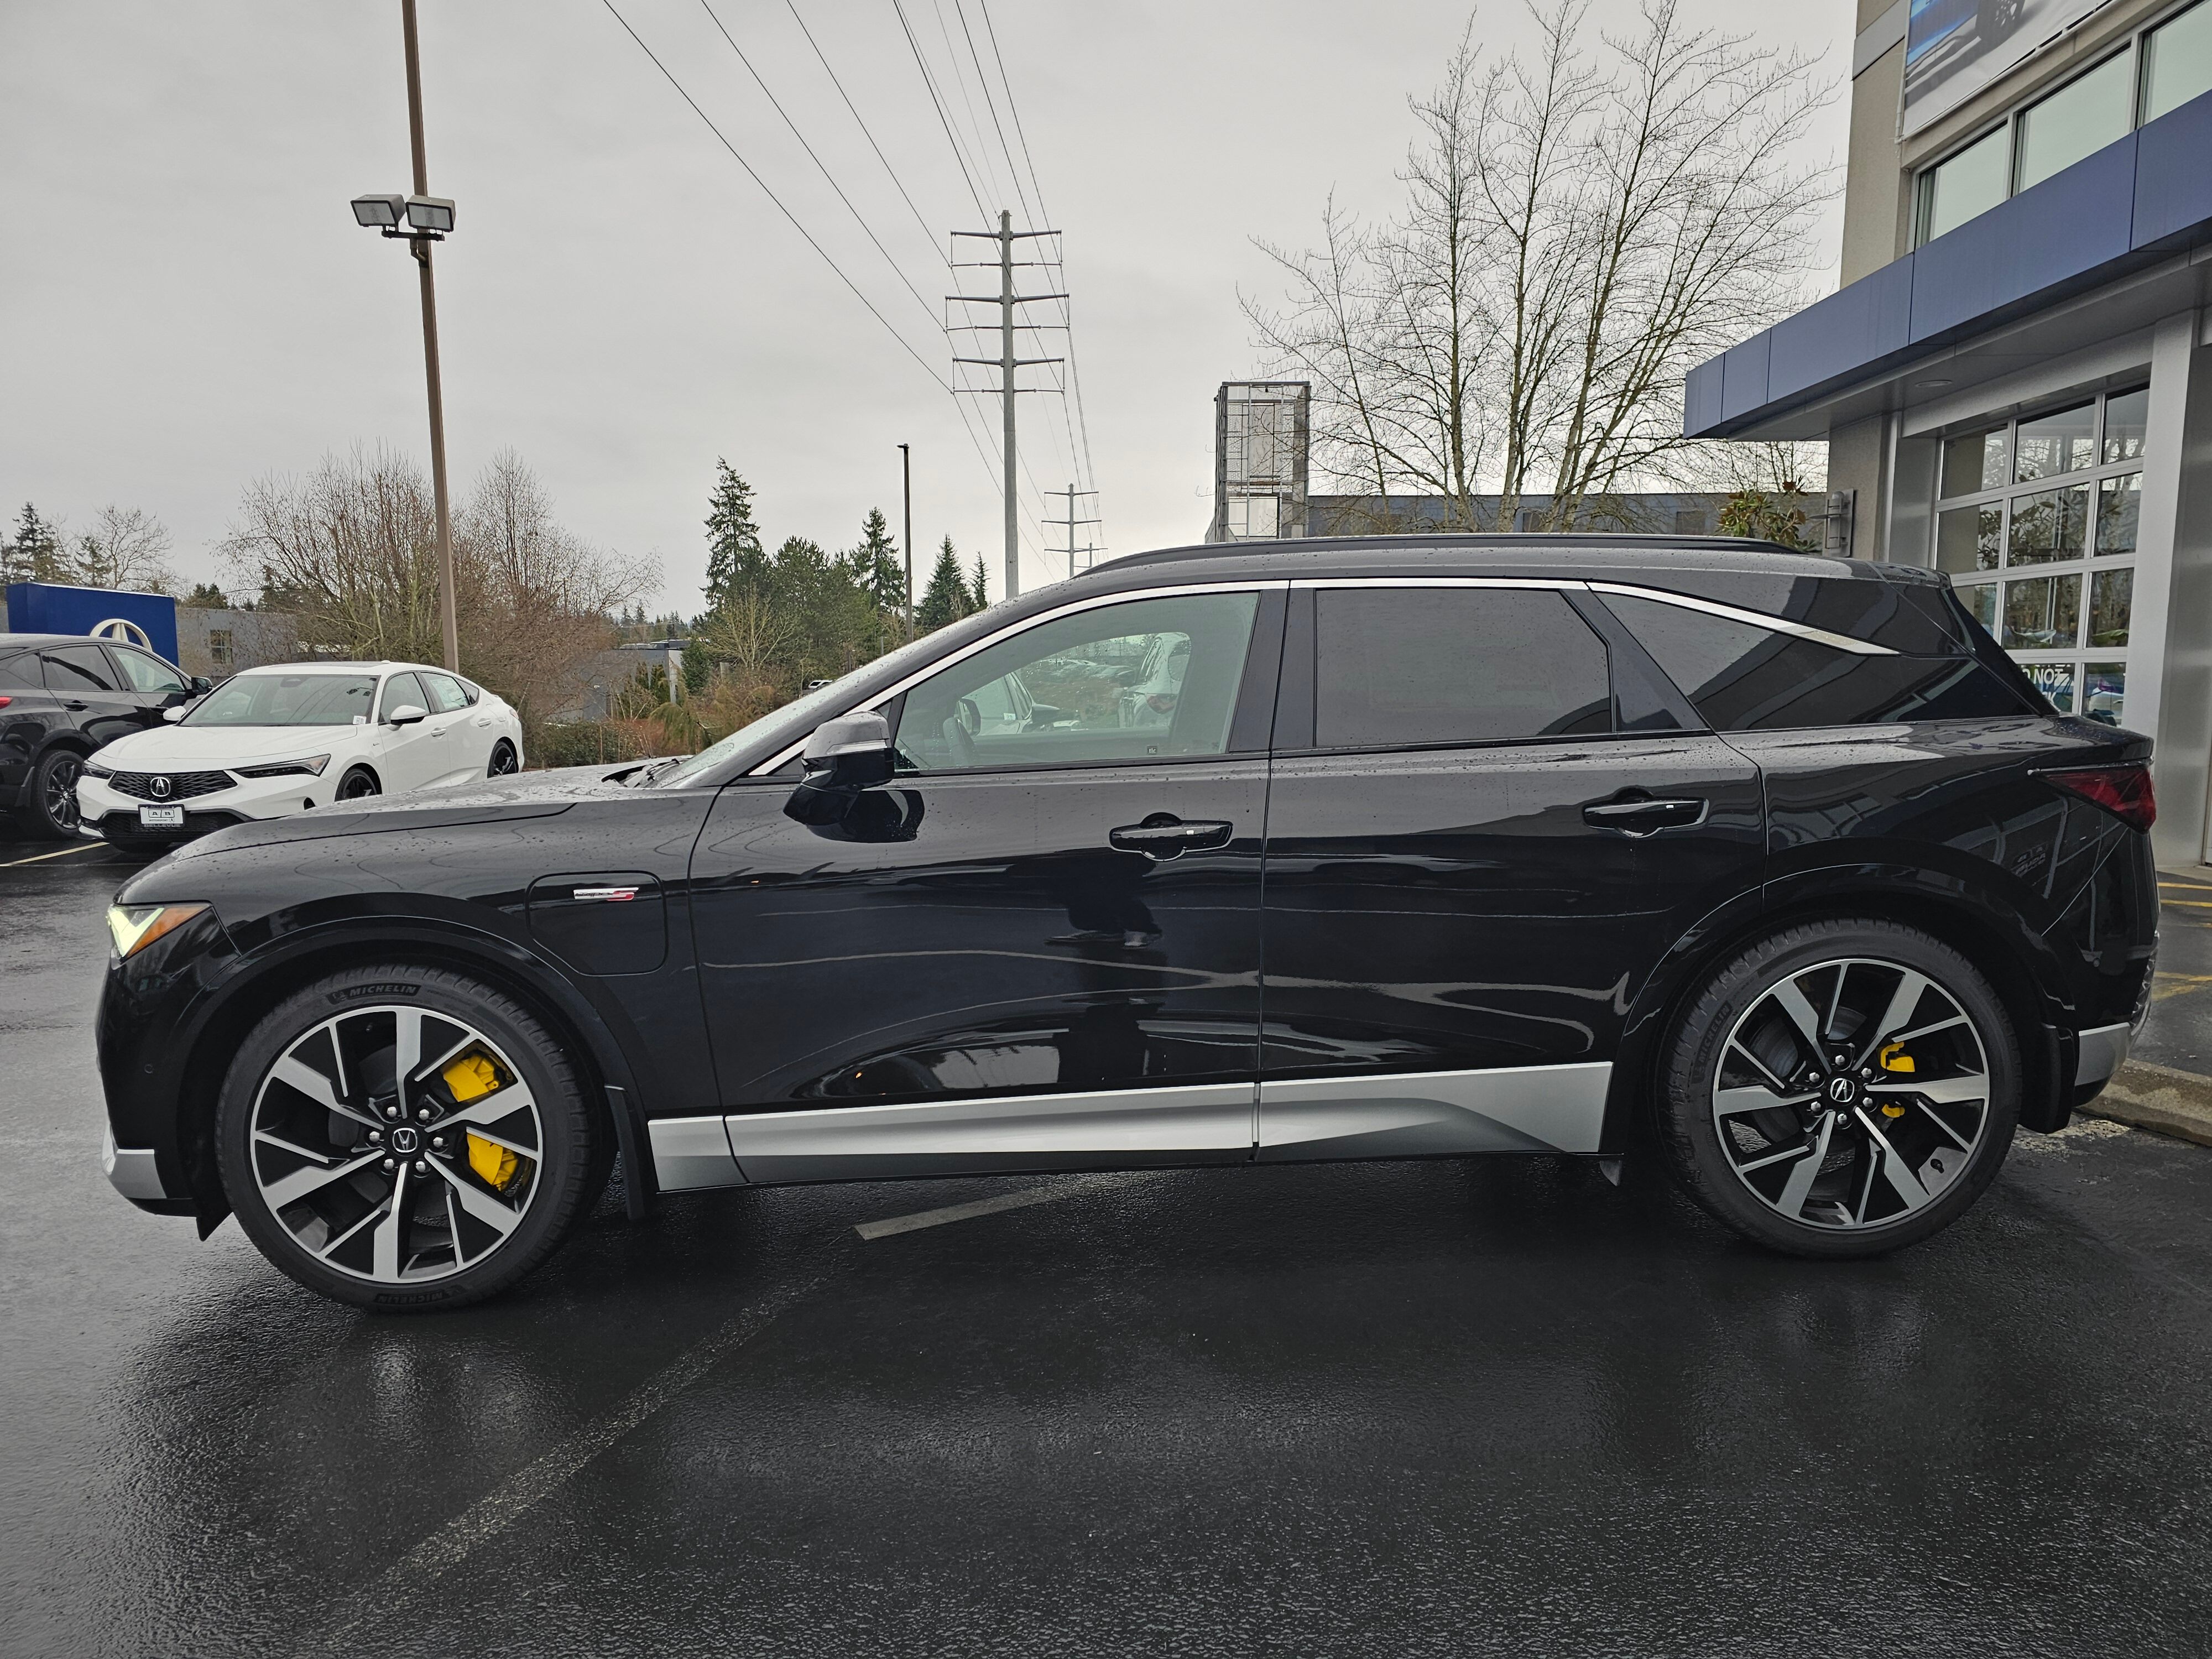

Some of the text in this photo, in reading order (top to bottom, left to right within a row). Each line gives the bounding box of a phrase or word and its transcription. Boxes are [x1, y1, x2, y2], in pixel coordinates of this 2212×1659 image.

[2033, 669, 2064, 685] NOT
[349, 985, 416, 997] MICHELIN
[1698, 1004, 1730, 1063] MICHELIN
[378, 1292, 443, 1304] MICHELIN
